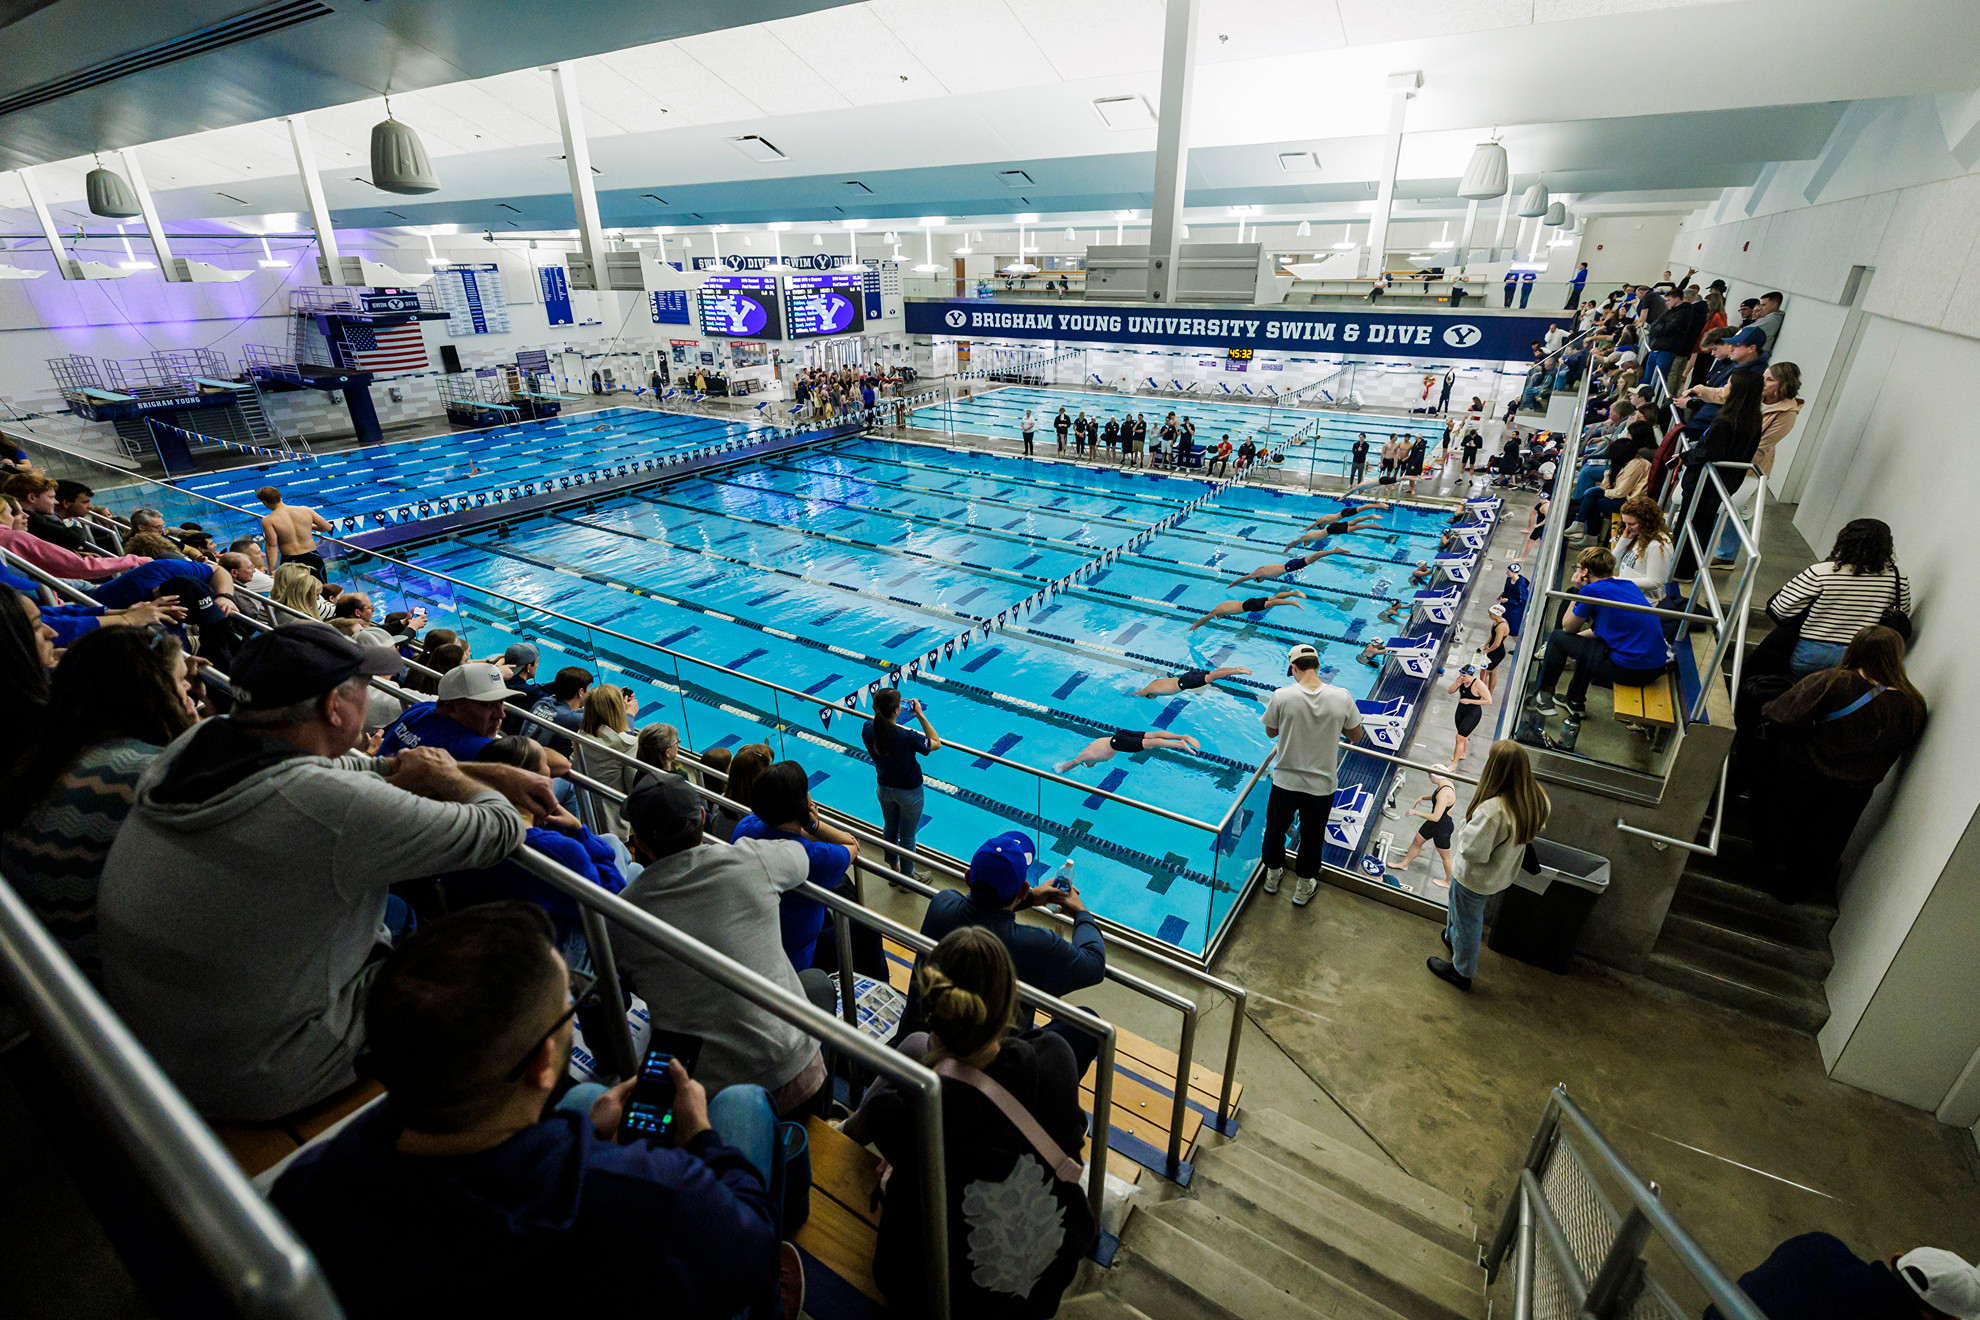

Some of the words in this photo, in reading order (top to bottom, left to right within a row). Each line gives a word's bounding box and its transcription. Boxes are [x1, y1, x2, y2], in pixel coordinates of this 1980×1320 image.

[972, 312, 1053, 329] BRIGHAM
[1058, 314, 1121, 332] YOUNG
[1128, 317, 1260, 338] UNIVERSITY
[1266, 320, 1336, 341] SWIM
[1343, 324, 1360, 342] &
[1367, 324, 1433, 345] DIVE
[1229, 349, 1252, 359] 45:32
[137, 400, 174, 409] BRIGHAM
[175, 396, 200, 405] YOUNG
[1411, 662, 1418, 670] 5
[1379, 731, 1386, 740] 6
[1333, 826, 1341, 836] 7
